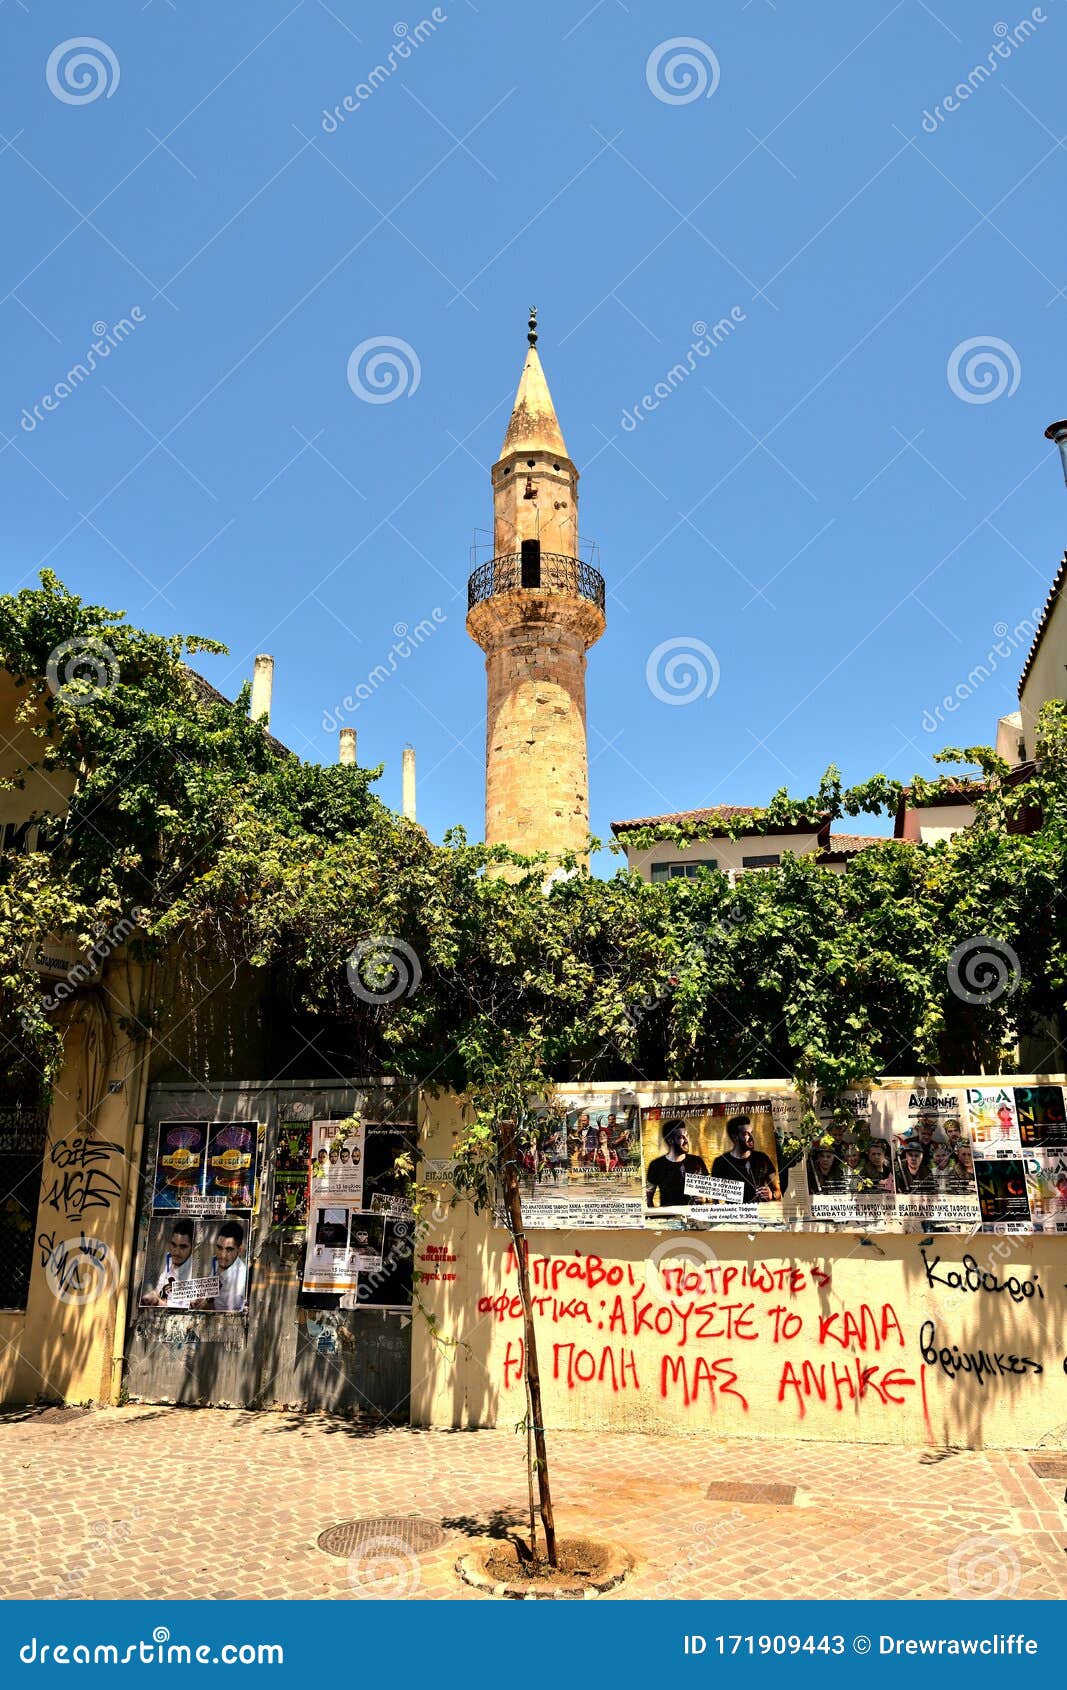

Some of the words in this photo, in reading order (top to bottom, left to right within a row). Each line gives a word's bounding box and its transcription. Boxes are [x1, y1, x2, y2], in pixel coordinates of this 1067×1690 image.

[811, 1204, 830, 1212] ΘΕΑΤΡΟ
[898, 1204, 917, 1212] ΘΕΑΤΡΟ
[920, 1249, 1044, 1303] Καθαροί
[553, 1342, 640, 1392] ΠΟΛΗ
[661, 1354, 749, 1412] ΜΑΣ
